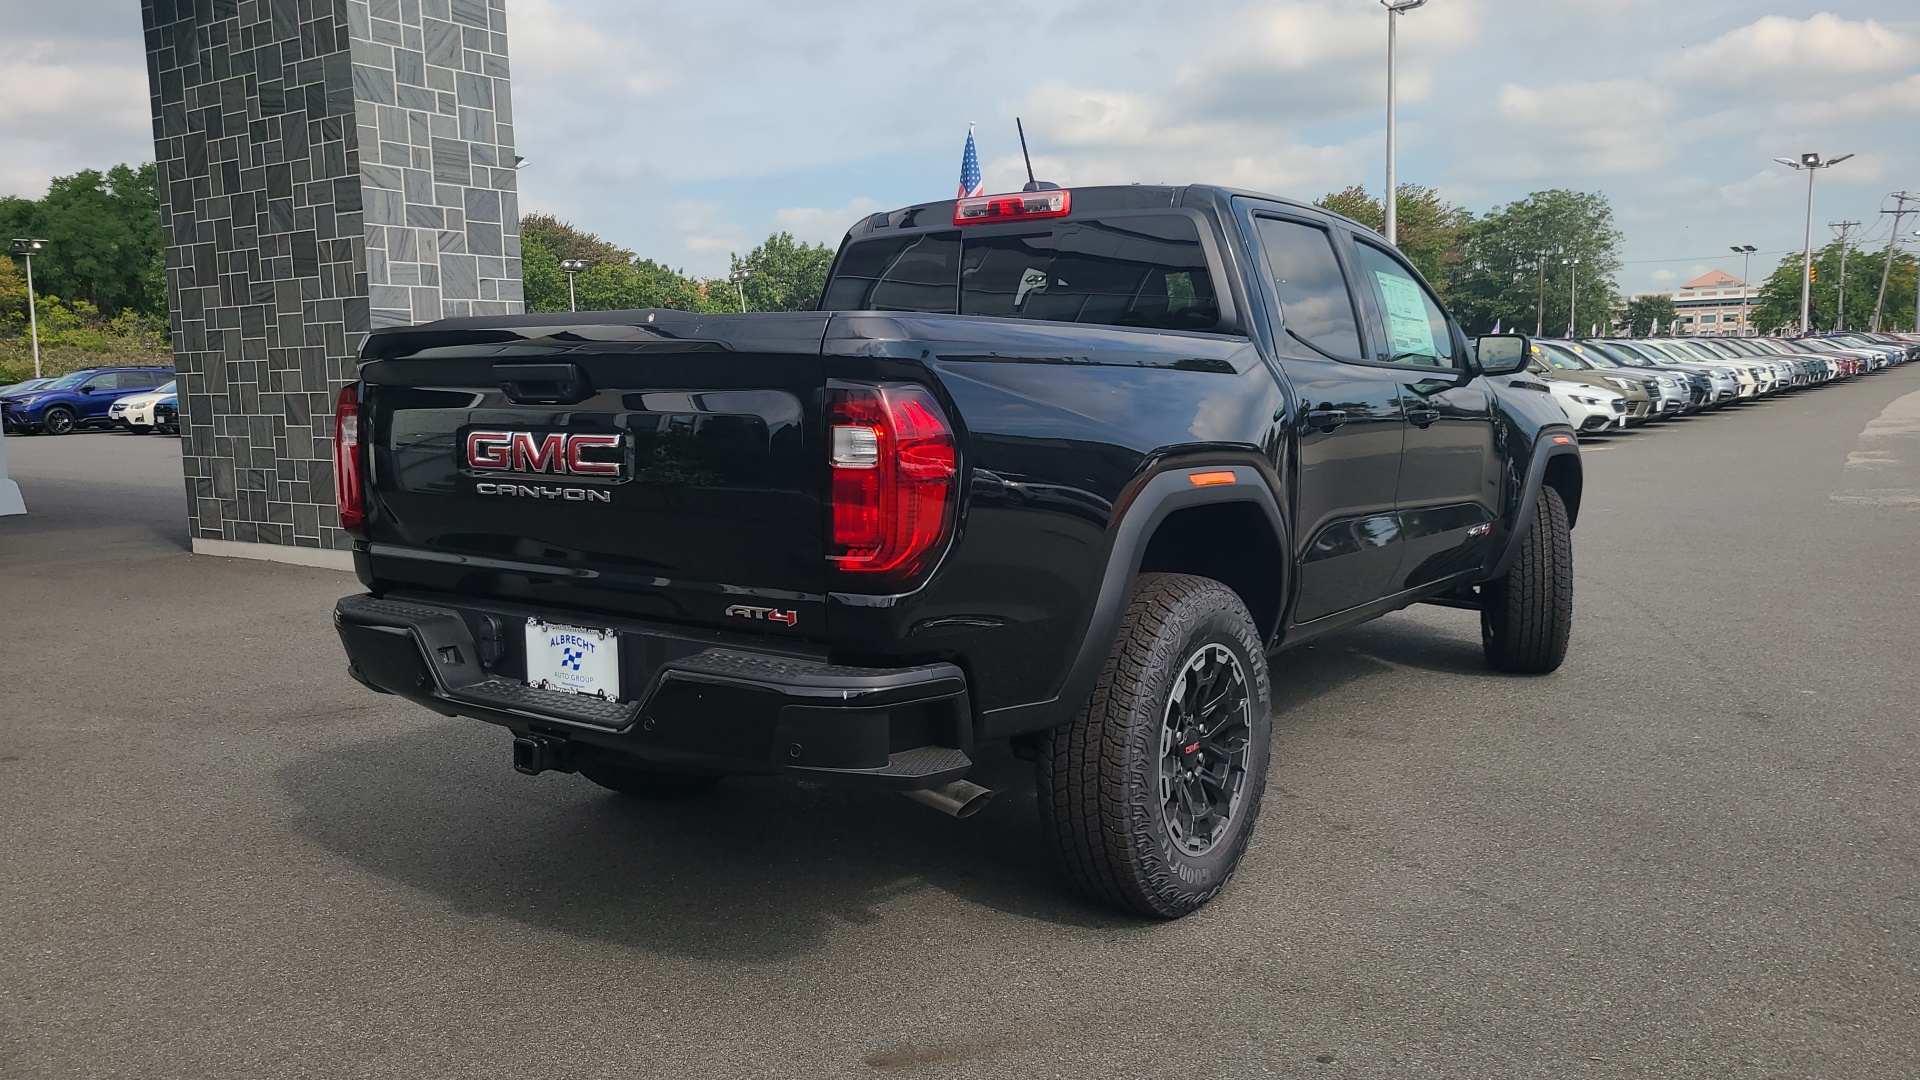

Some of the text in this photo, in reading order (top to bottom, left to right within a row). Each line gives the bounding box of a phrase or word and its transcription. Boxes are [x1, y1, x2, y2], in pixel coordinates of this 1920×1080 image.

[467, 431, 621, 477] GMC
[476, 483, 612, 503] CANYON
[725, 604, 798, 627] AT4
[550, 634, 595, 653] ALBRECHT
[554, 671, 594, 683] AUTO GROUP
